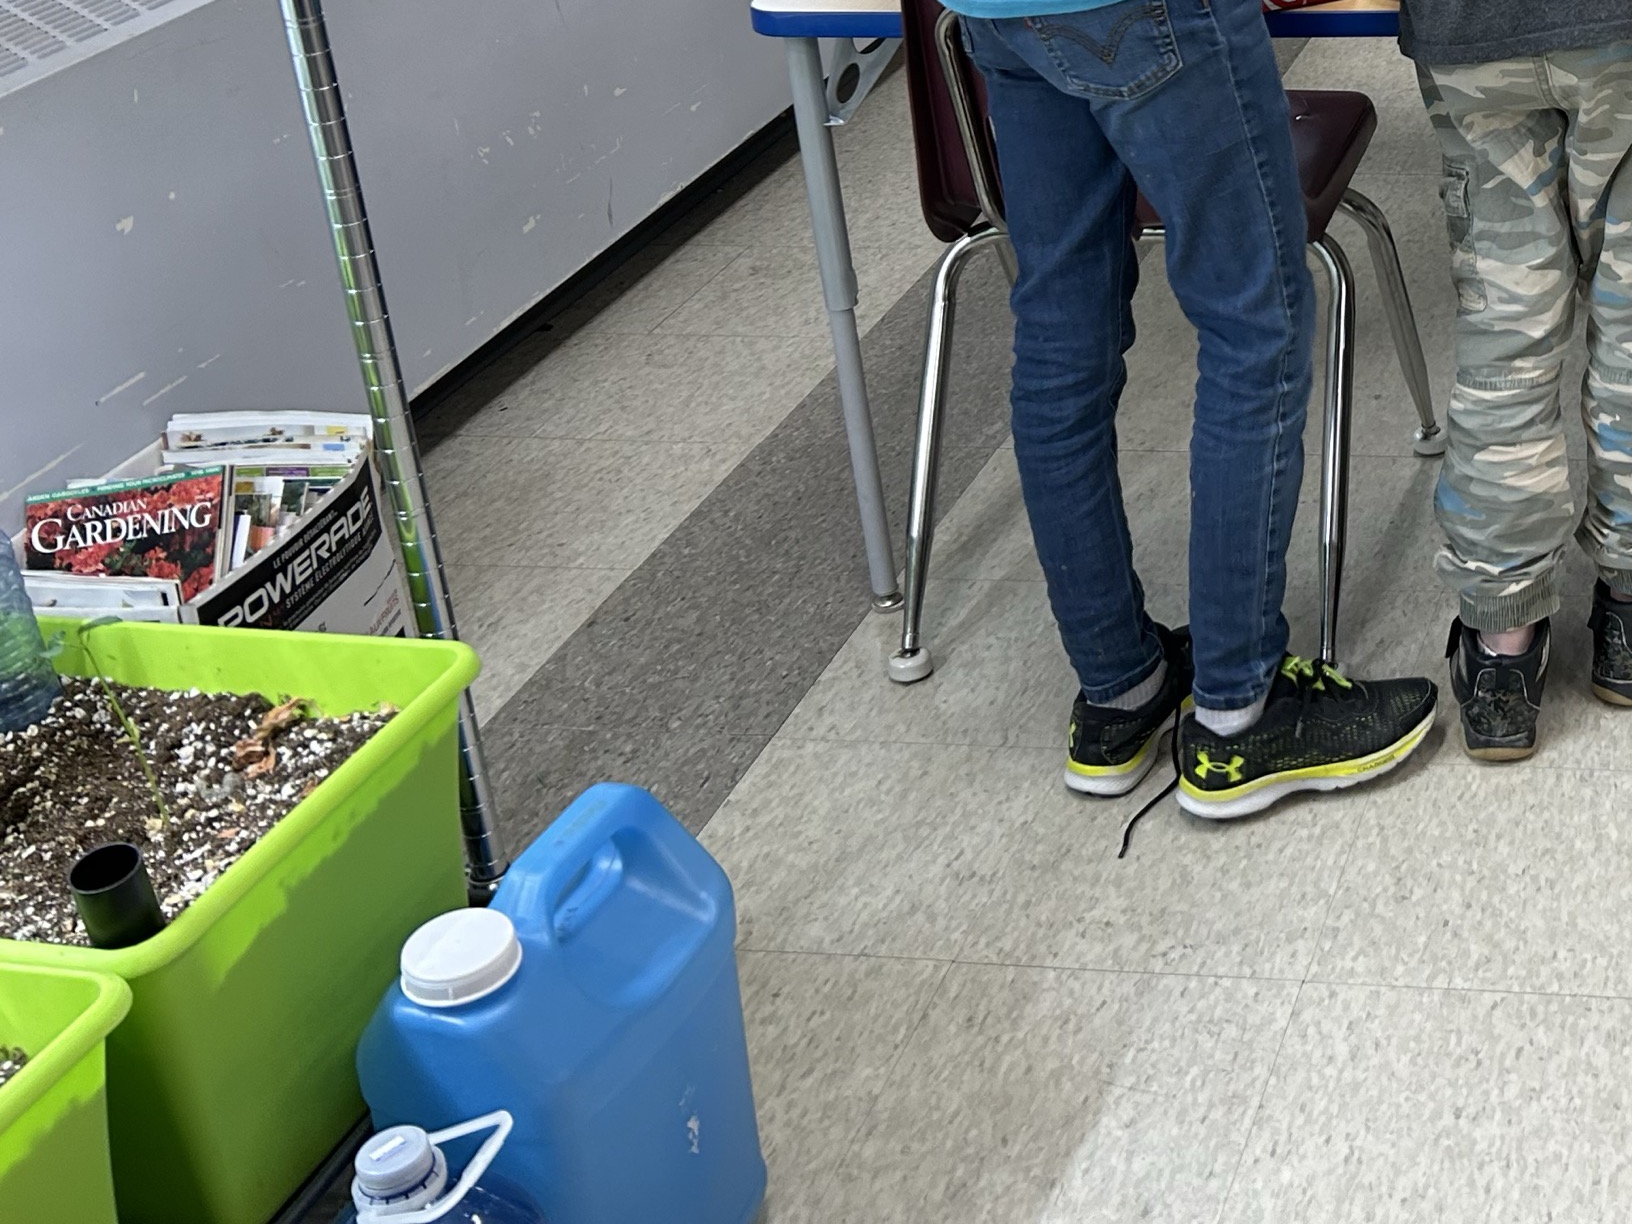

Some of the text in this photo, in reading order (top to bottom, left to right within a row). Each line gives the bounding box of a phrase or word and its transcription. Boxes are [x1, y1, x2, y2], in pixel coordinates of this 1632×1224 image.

[31, 501, 213, 555] GARDENING
[66, 498, 149, 522] CANADIAN
[217, 486, 373, 628] POWERADE
